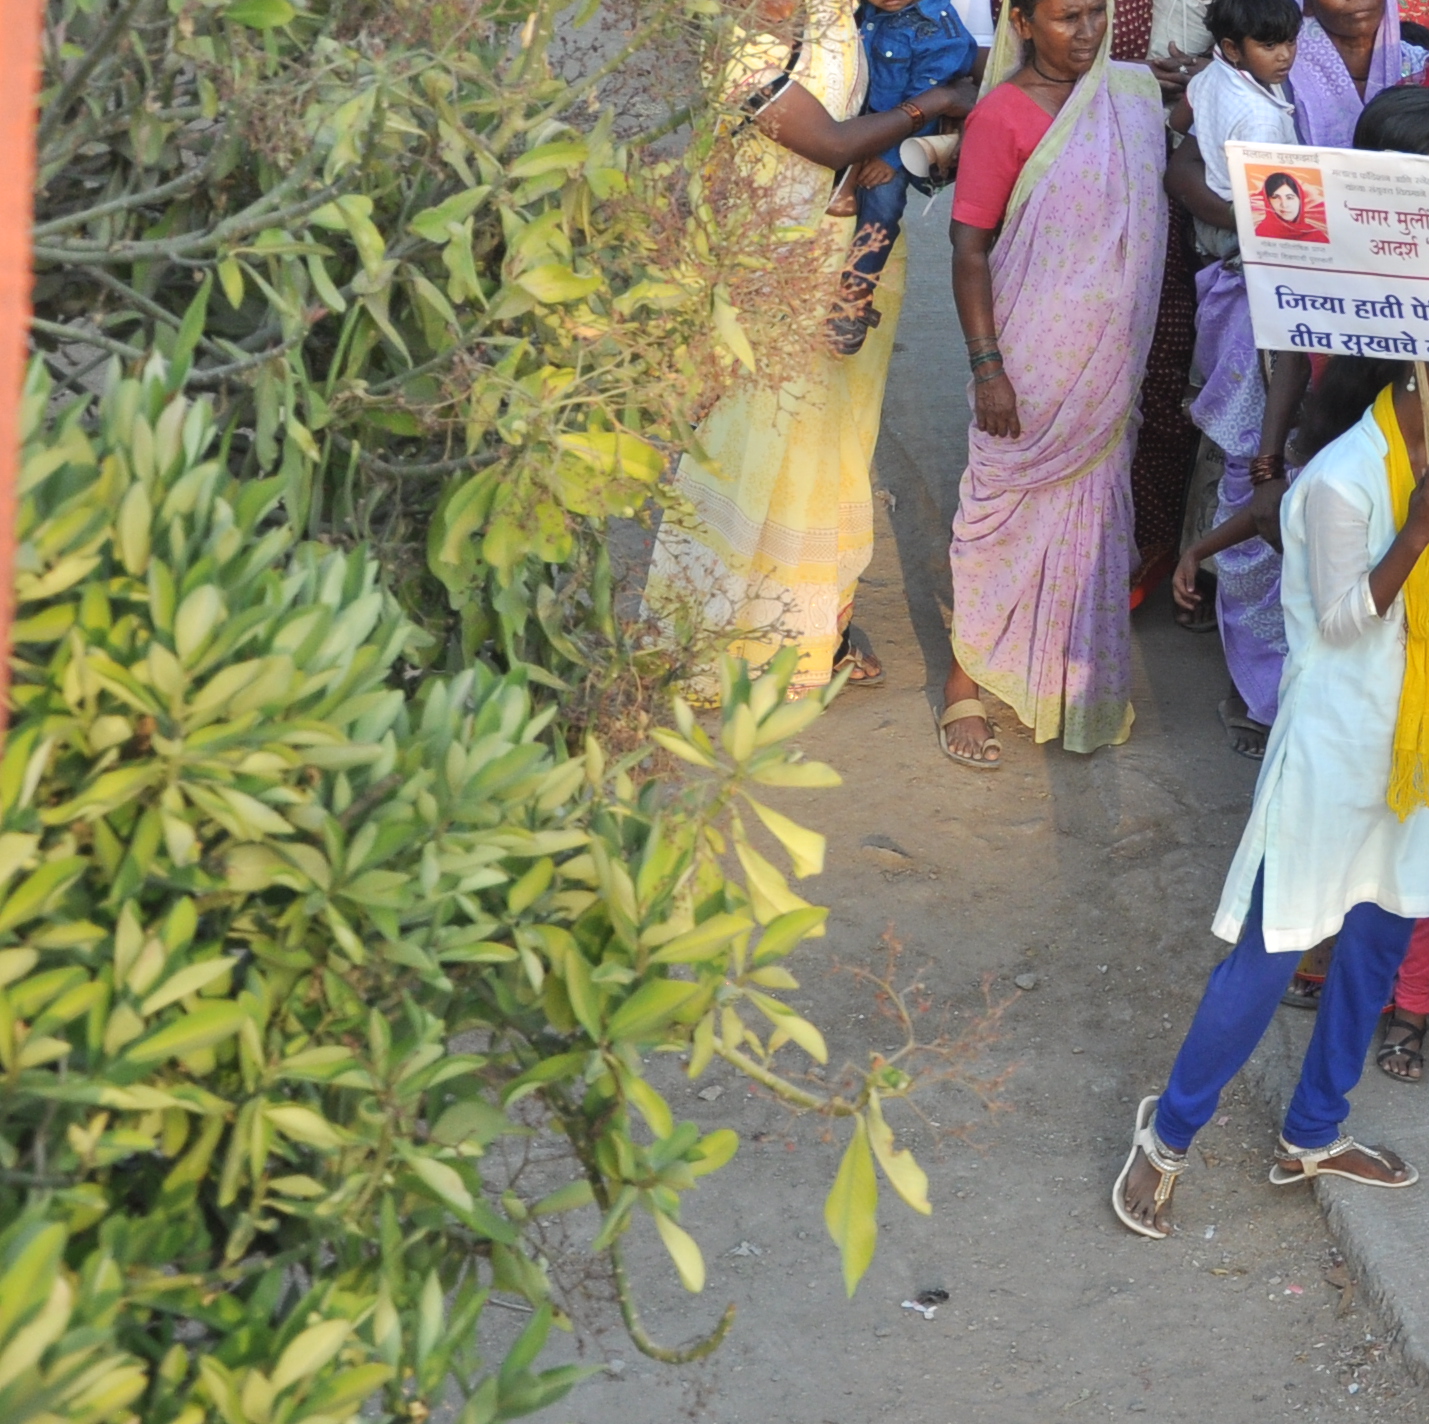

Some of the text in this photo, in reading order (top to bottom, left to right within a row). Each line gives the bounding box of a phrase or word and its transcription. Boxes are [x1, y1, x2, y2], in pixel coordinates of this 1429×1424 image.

[1343, 201, 1389, 228] ‘जागर
[1369, 236, 1420, 260] आदर्श
[1275, 285, 1345, 314] जिच्या
[1352, 294, 1404, 320] हाती
[1288, 323, 1333, 349] तीच
[1340, 330, 1418, 357] सुखाचे
